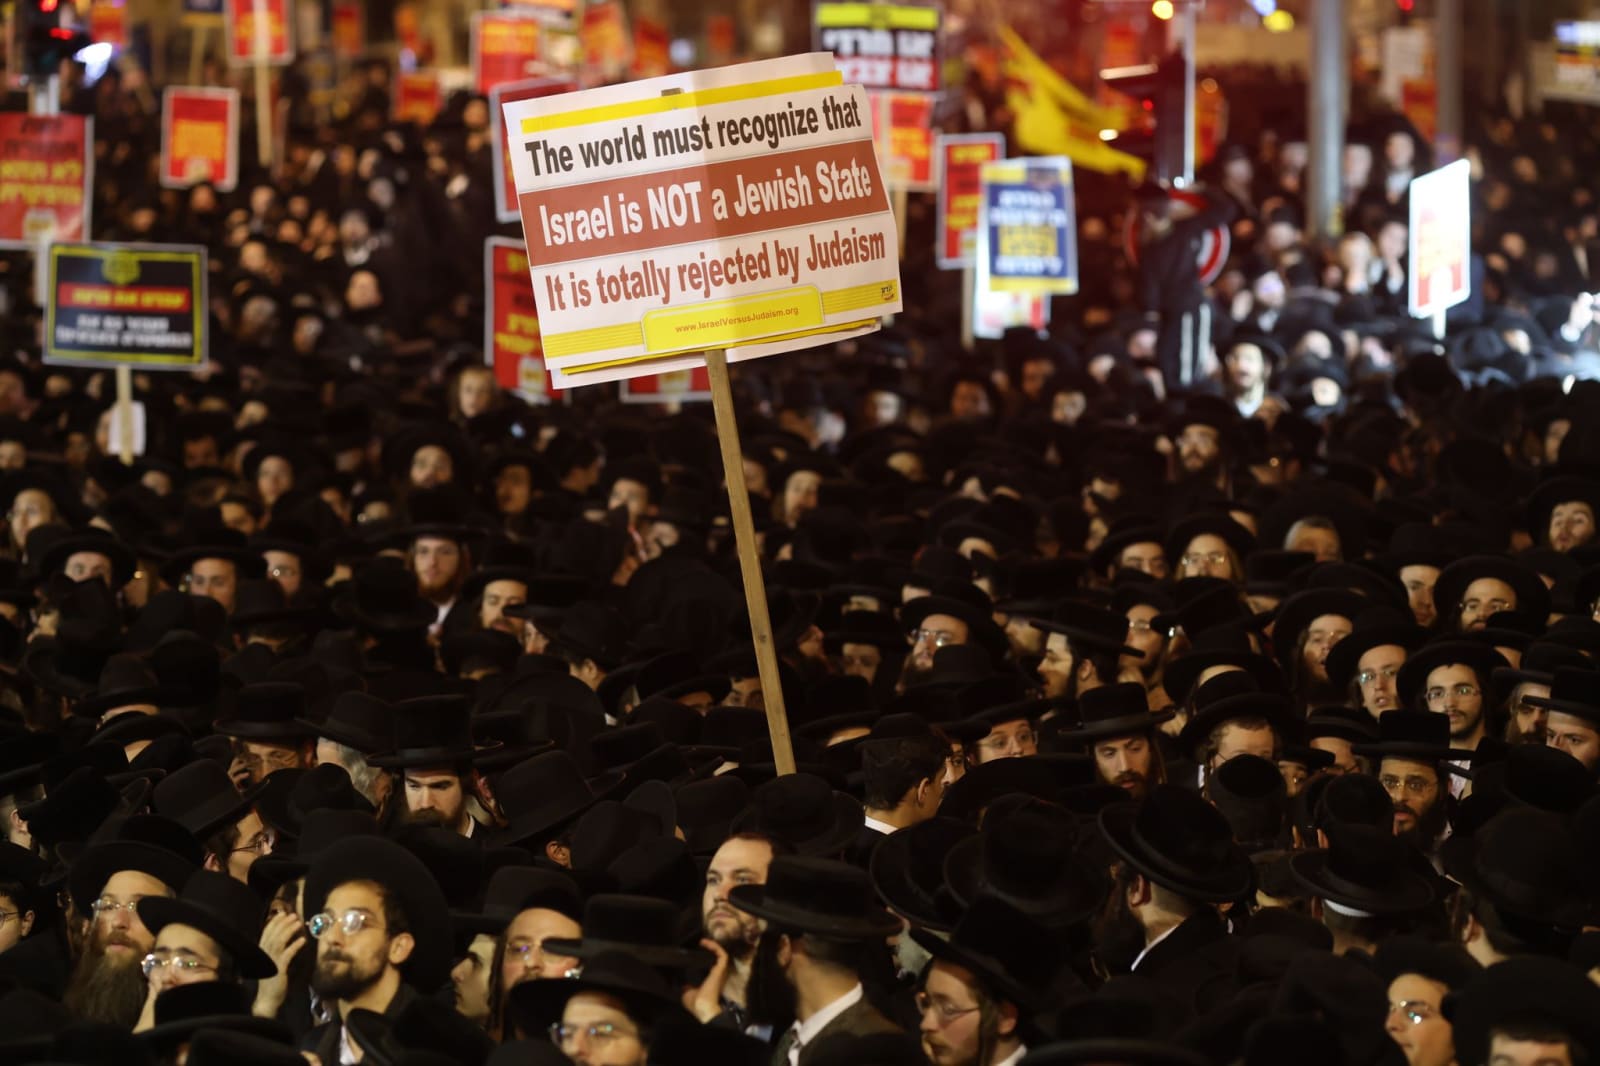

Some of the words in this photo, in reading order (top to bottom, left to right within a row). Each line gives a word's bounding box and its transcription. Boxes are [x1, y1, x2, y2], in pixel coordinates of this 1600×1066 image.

[525, 140, 574, 177] The
[579, 125, 647, 164] world
[653, 116, 714, 154] must
[718, 100, 819, 149] recognize
[823, 93, 862, 131] that
[539, 195, 614, 247] Israel
[619, 193, 644, 235] is
[647, 181, 703, 230] NOT
[712, 189, 728, 221] a
[734, 165, 813, 217] Jewish
[817, 157, 873, 203] State
[545, 274, 566, 311] It
[569, 269, 592, 308] is
[596, 260, 671, 304] totally
[677, 240, 770, 296] rejected
[774, 236, 800, 284] by
[806, 227, 886, 272] Judaism
[675, 305, 799, 333] www.IsraelVersusJudaism.org
